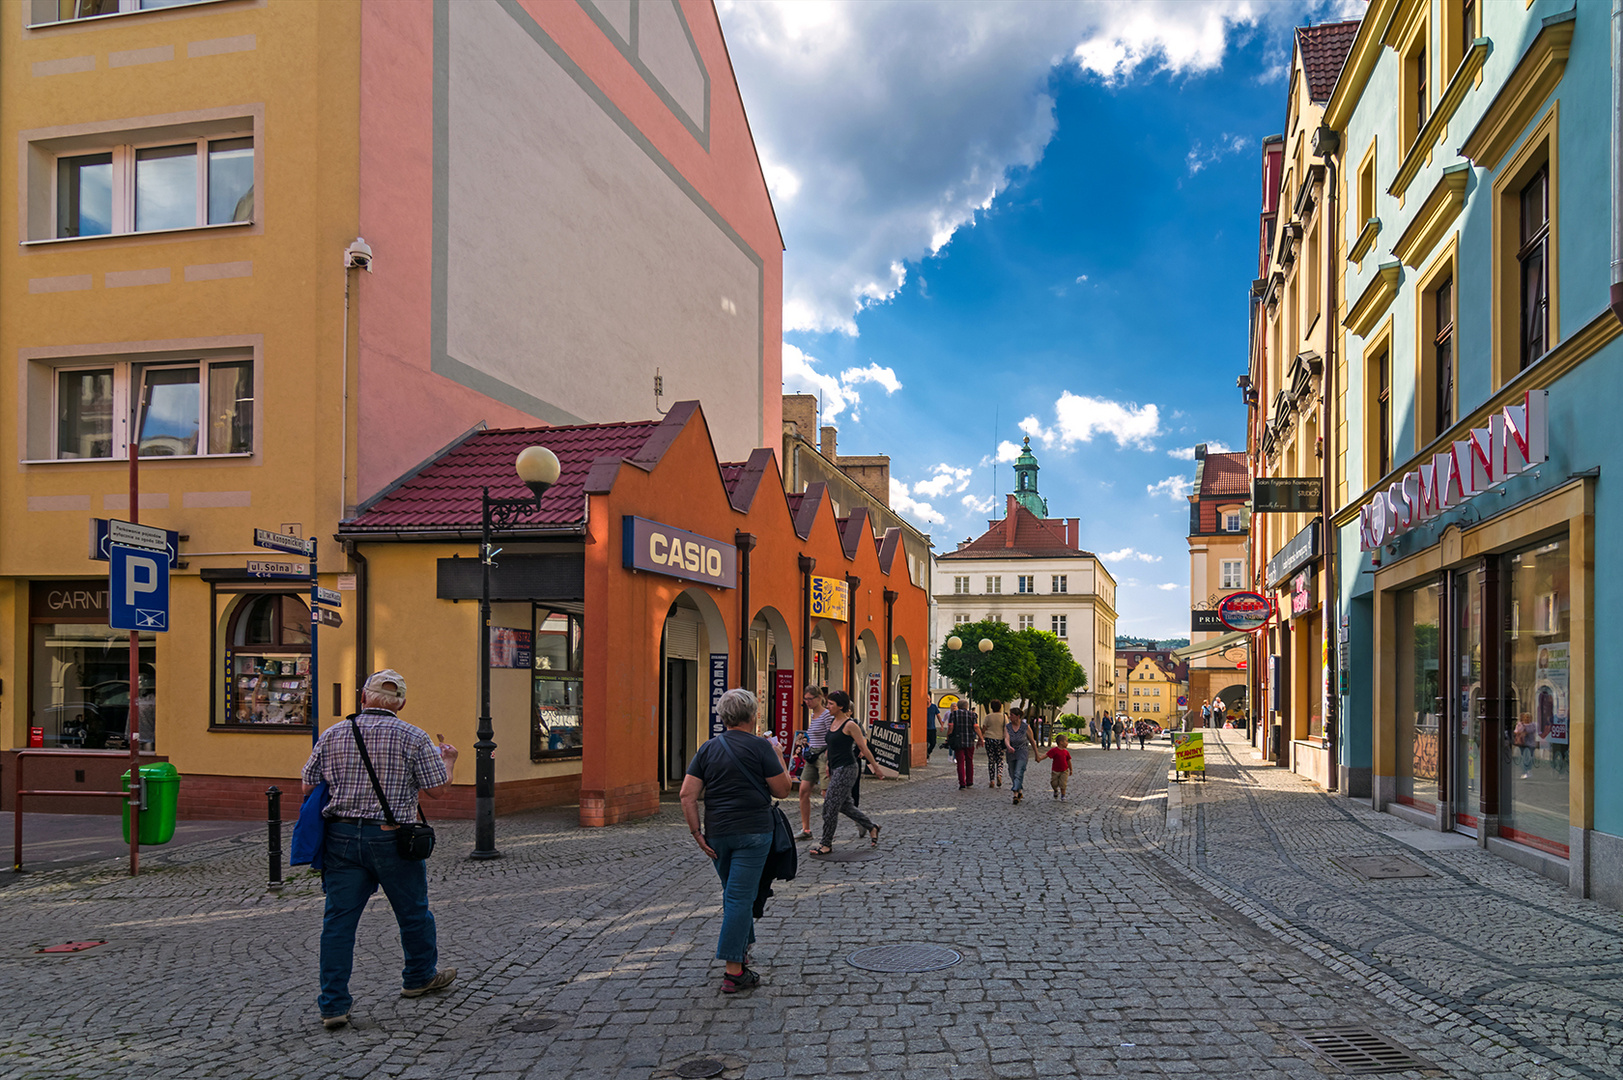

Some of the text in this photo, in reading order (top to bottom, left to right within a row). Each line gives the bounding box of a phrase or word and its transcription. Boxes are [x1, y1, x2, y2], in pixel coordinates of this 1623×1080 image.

[1360, 389, 1549, 552] ROSSMANN
[288, 526, 294, 535] 1
[649, 532, 722, 577] CASIO
[125, 554, 158, 606] P
[812, 577, 823, 614] GSM
[779, 692, 789, 753] TELEFONY
[872, 725, 904, 746] KANTOR
